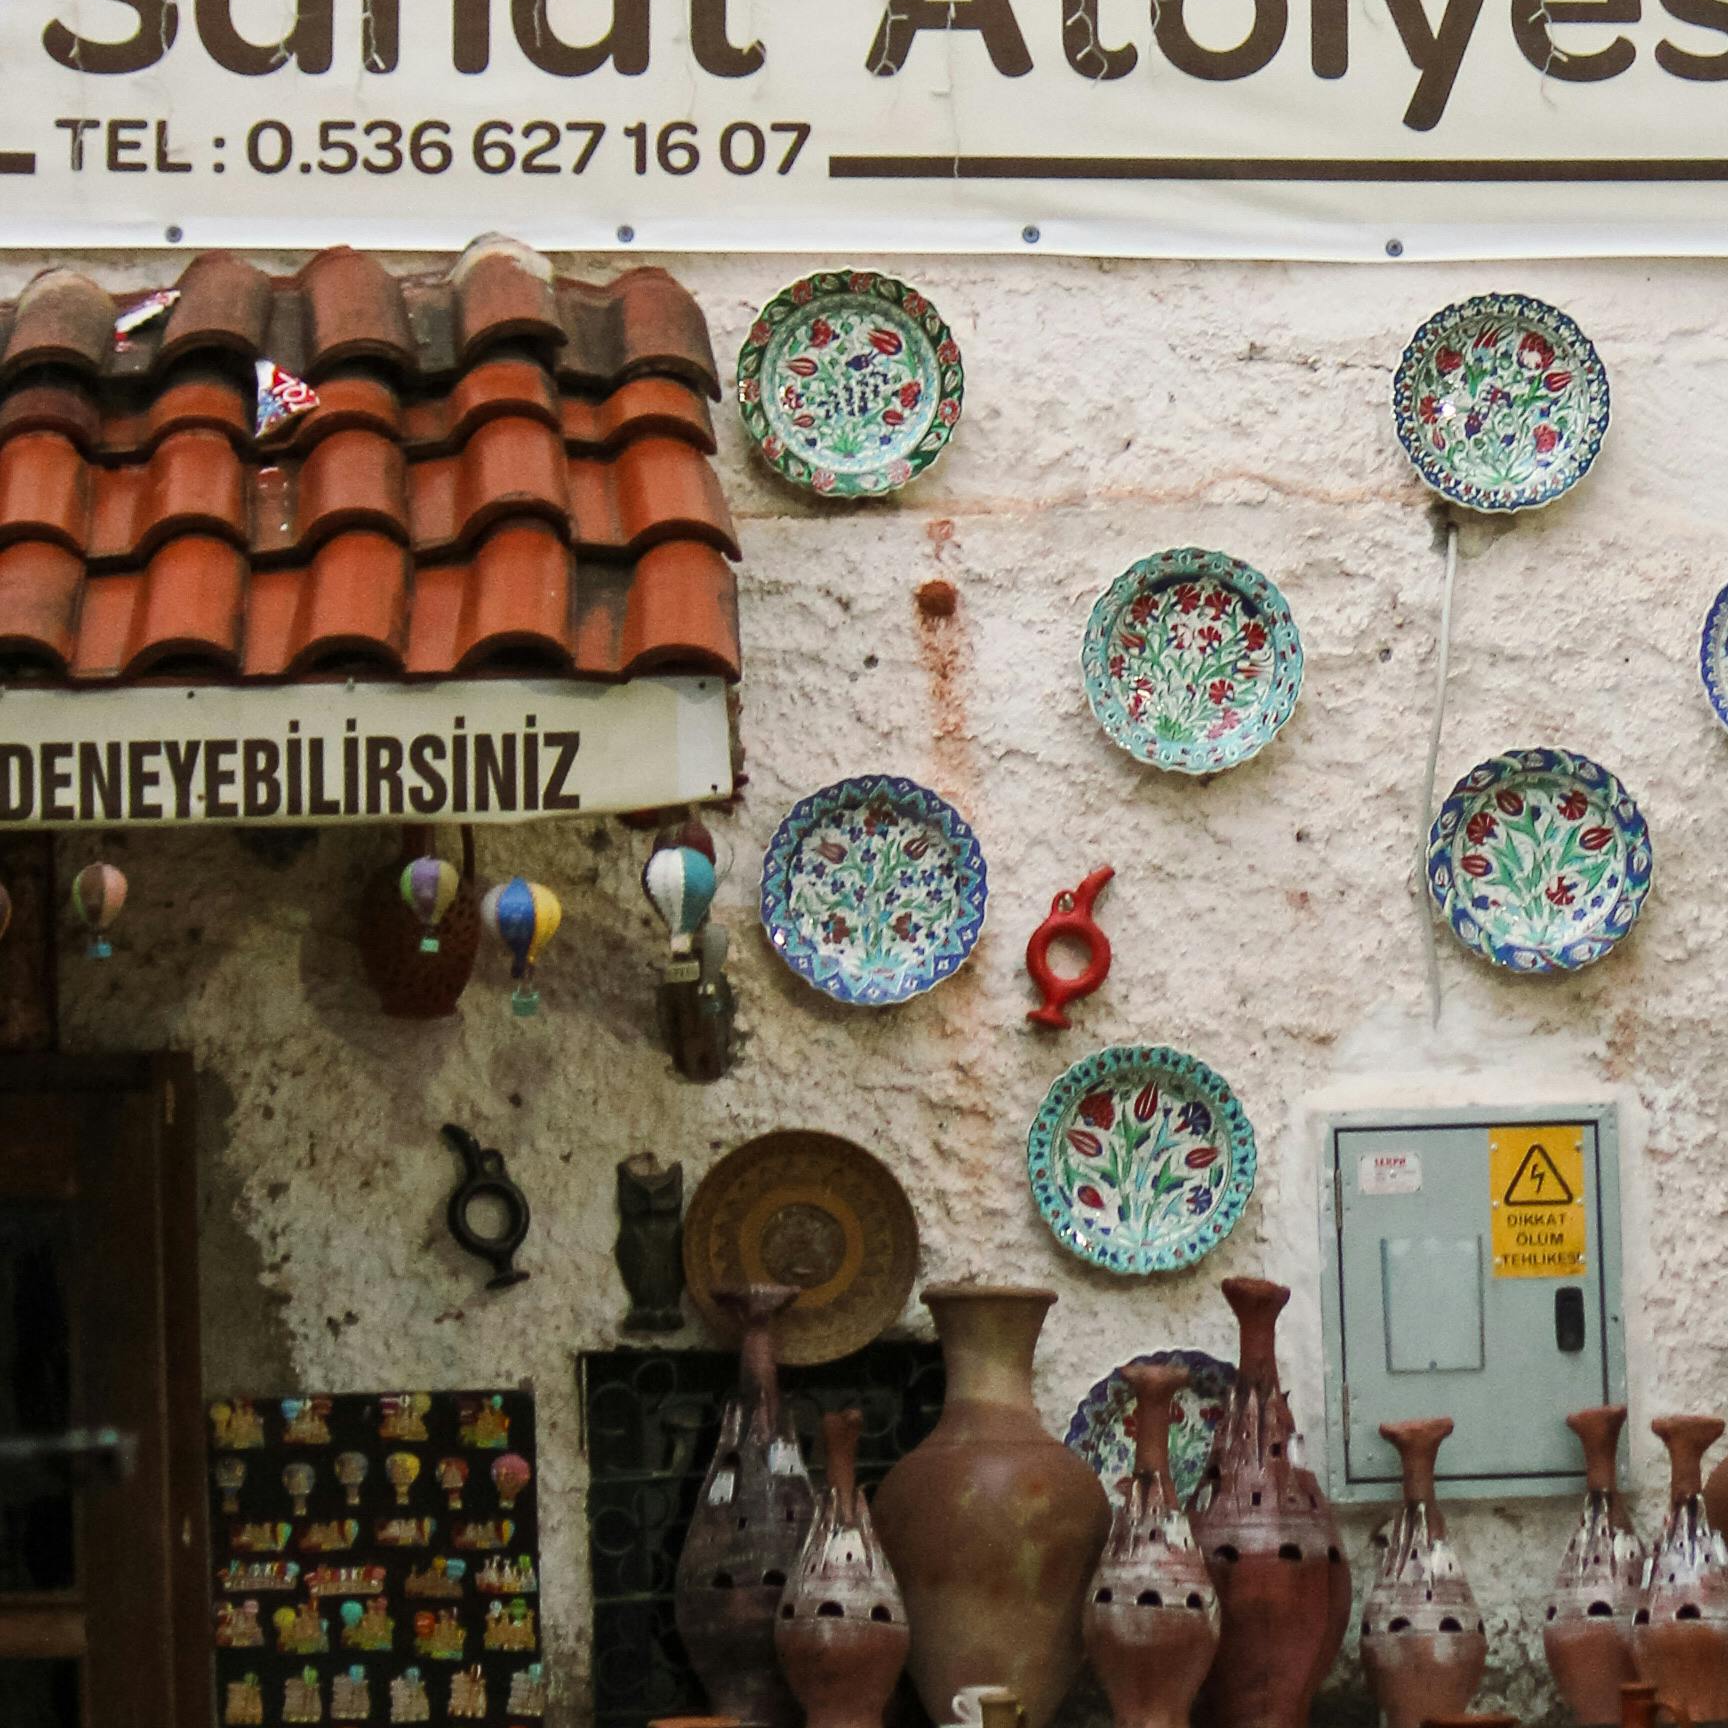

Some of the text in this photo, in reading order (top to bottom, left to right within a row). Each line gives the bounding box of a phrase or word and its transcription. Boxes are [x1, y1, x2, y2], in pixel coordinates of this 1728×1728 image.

[248, 121, 452, 174] 0.536
[473, 121, 605, 174] 627
[624, 122, 699, 175] 16
[720, 122, 810, 175] 07
[0, 714, 580, 821] DENEYEBİLİRSİNİZ
